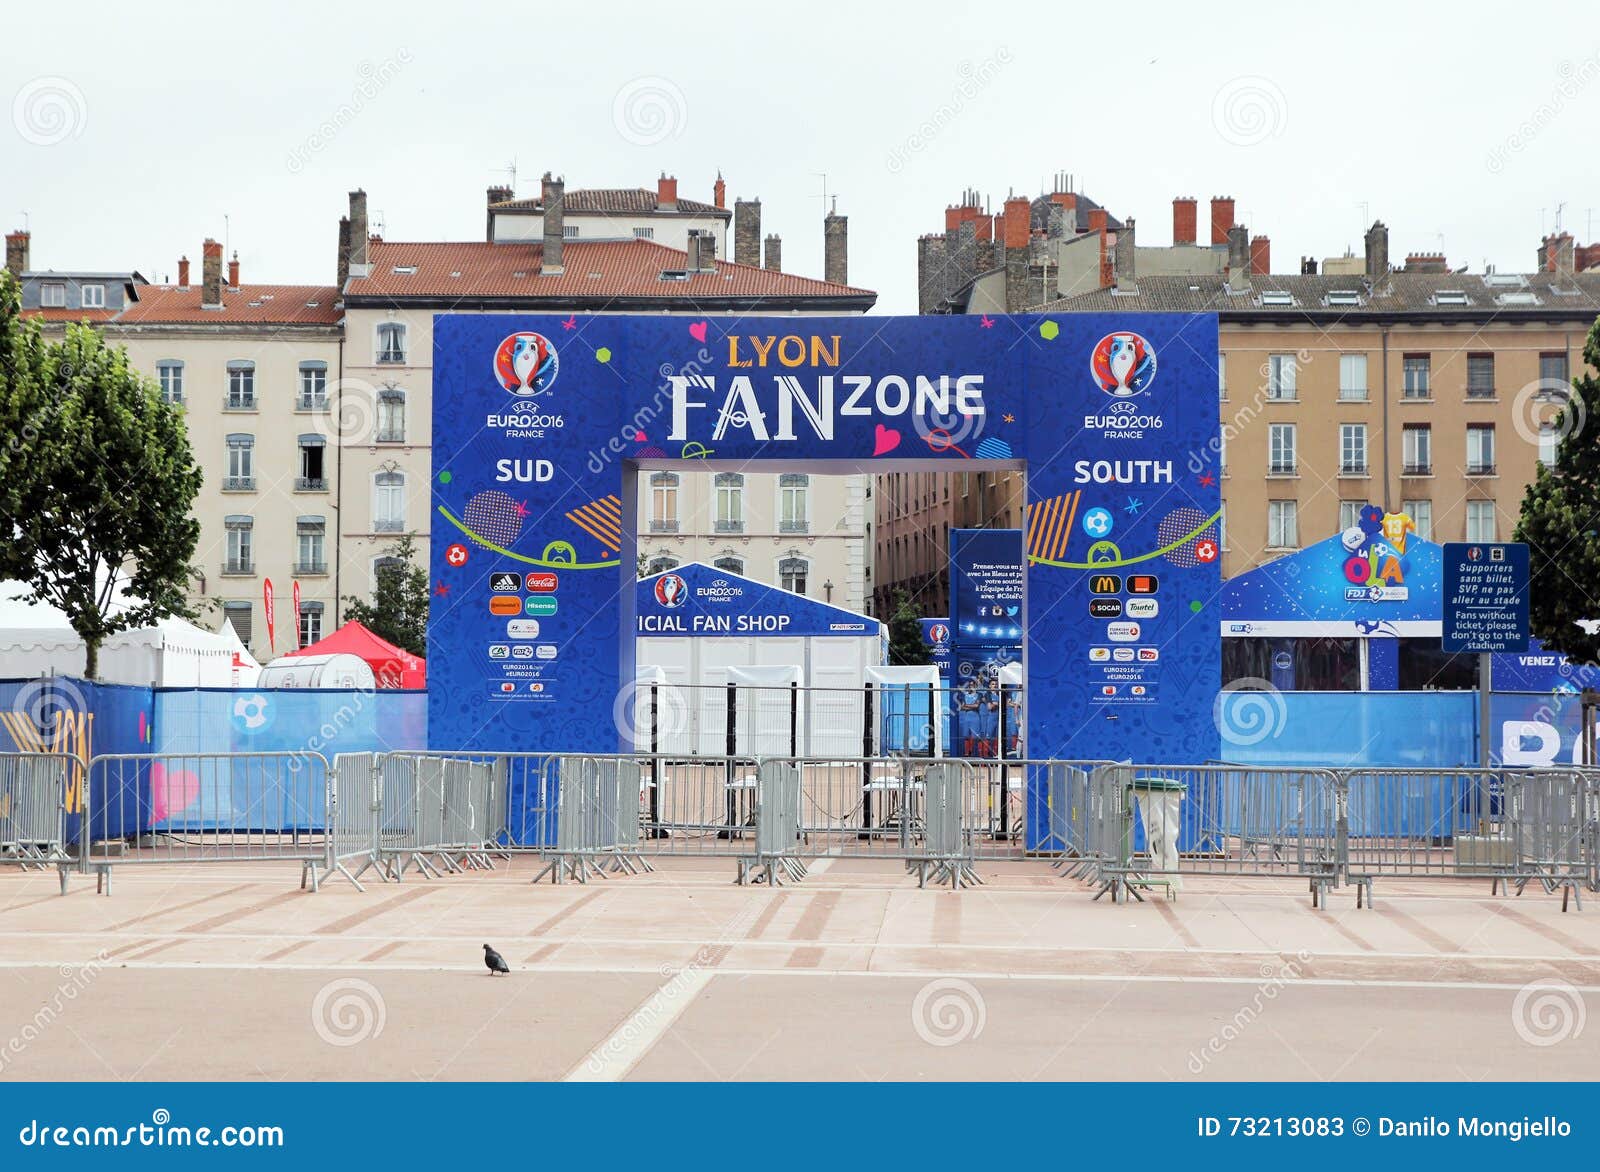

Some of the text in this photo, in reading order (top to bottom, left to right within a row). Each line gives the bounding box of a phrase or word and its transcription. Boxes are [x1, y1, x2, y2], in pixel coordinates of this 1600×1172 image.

[727, 335, 841, 367] LYON
[513, 402, 537, 413] UEFA
[667, 375, 985, 441] FAN ZONE
[1110, 403, 1136, 415] UEFA
[487, 414, 564, 428] EURO2016
[1084, 416, 1163, 429] EURO2016
[506, 430, 544, 438] FRANCE
[1104, 431, 1143, 439] FRANCE
[496, 459, 554, 482] SUD
[1074, 460, 1173, 483] SOUTH
[1358, 549, 1368, 558] LA
[1345, 544, 1404, 587] OLA
[1459, 563, 1513, 573] Supporters
[1487, 574, 1514, 584] billet,
[697, 587, 743, 596] EURO2016
[1347, 589, 1366, 598] FDJ
[1497, 586, 1514, 595] pas
[1452, 596, 1474, 604] aller
[1494, 596, 1520, 604] stade
[1130, 603, 1154, 611] Tourtel
[1456, 611, 1516, 620] Fans without
[636, 615, 790, 631] ICIAL FAN SHOP
[1456, 621, 1517, 631] ticket, please
[1479, 633, 1490, 641] go
[1493, 632, 1502, 640] to
[1505, 631, 1521, 640] the
[1467, 641, 1505, 649] stadium
[1519, 656, 1571, 666] VENEZ V
